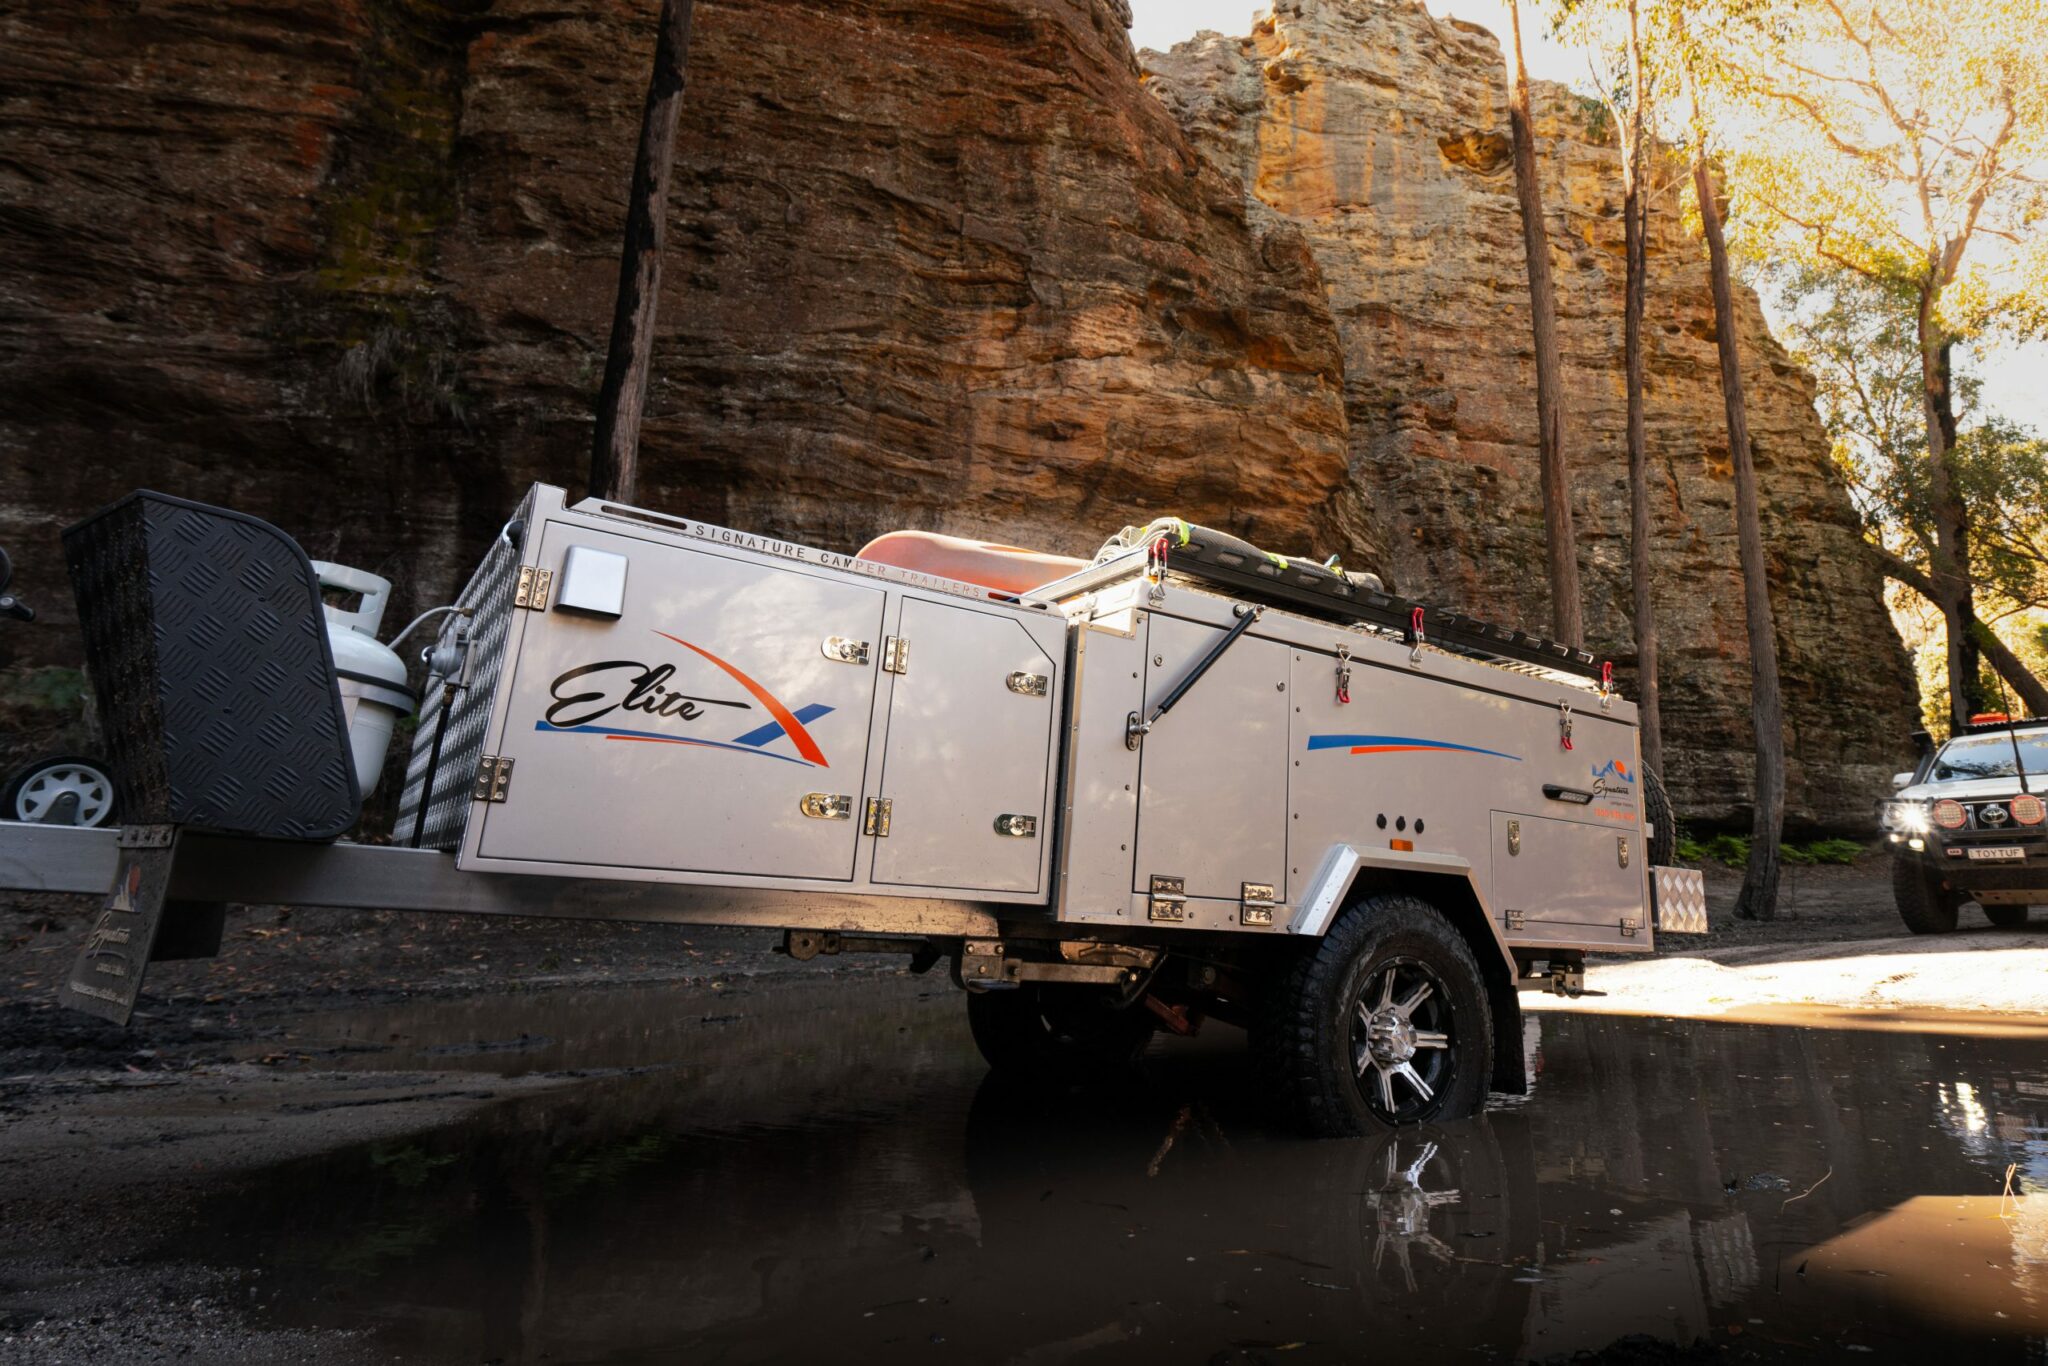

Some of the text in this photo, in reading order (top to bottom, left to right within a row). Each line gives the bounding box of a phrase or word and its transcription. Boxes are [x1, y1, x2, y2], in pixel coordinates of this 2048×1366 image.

[695, 523, 982, 598] SIGNATURE CAMPER TRAILERS
[545, 660, 752, 728] Elite
[1975, 848, 2020, 858] TOYTUF
